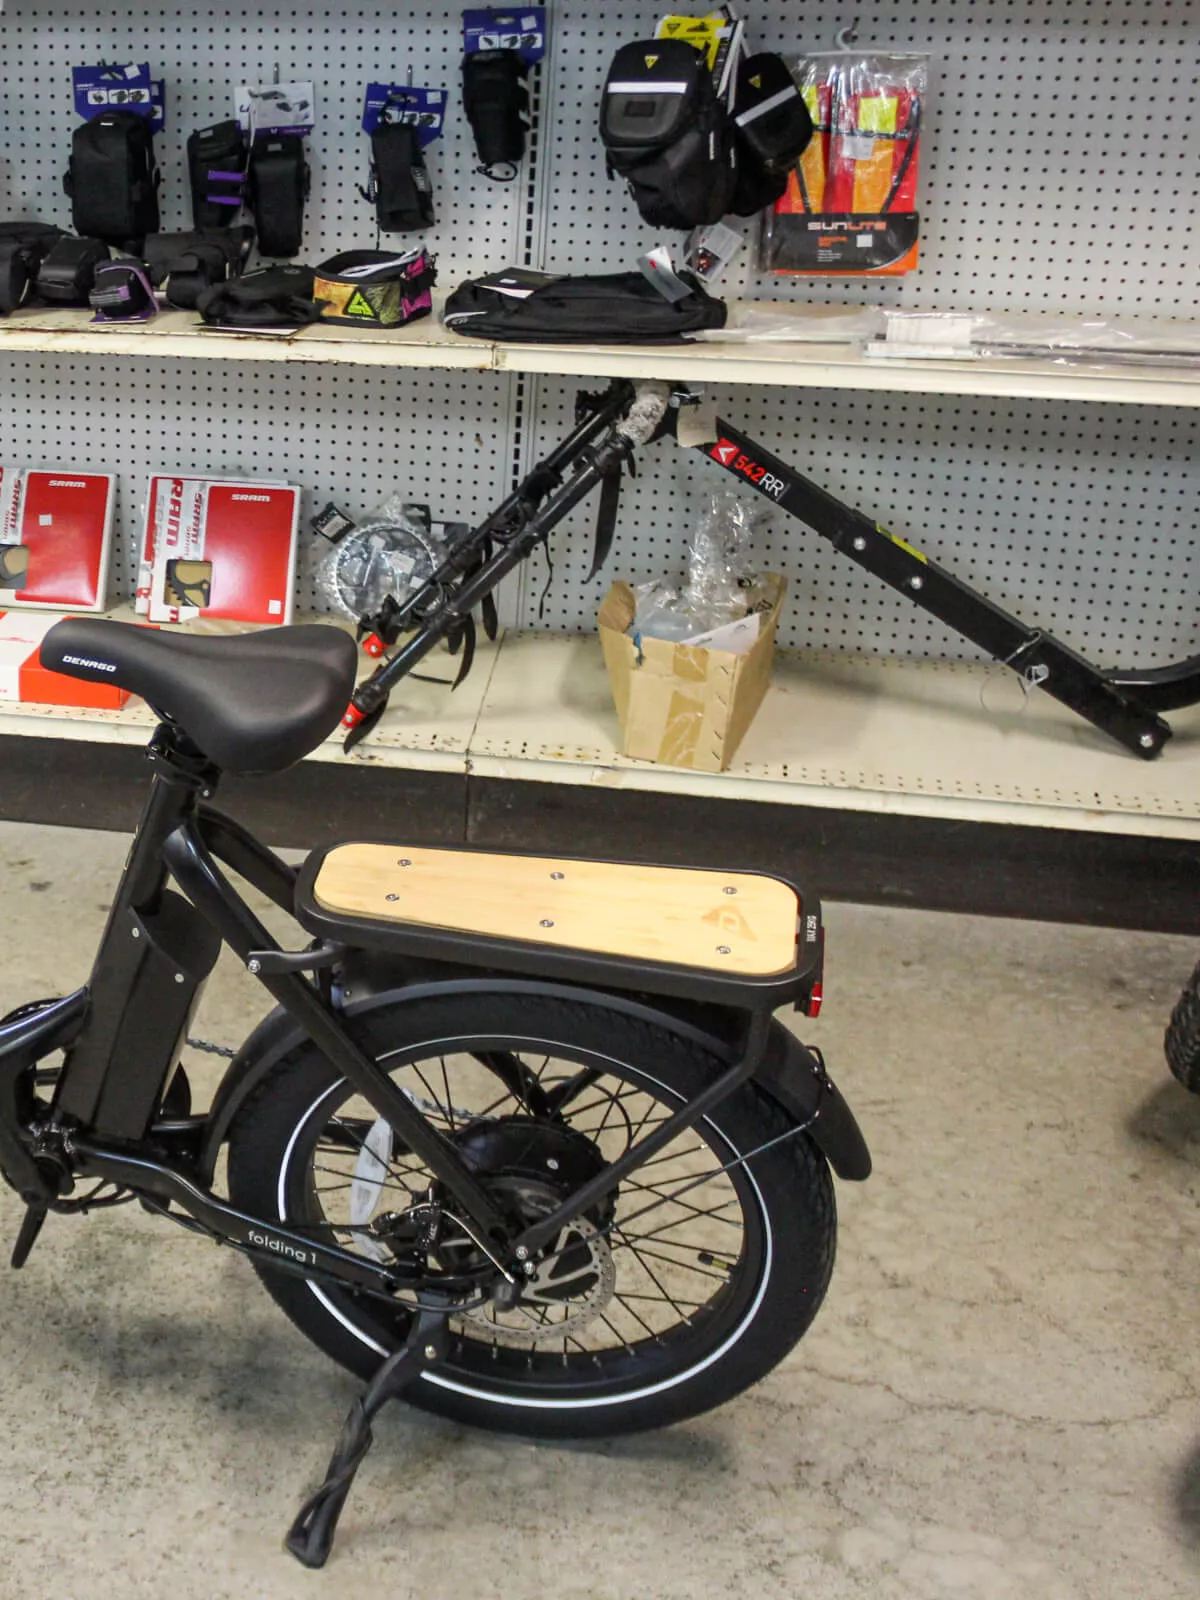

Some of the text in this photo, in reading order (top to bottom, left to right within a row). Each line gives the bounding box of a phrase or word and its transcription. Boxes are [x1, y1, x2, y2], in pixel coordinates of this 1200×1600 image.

[48, 480, 87, 488] SRAM
[231, 493, 271, 502] SRAM
[62, 654, 118, 673] DENAGO
[248, 1230, 317, 1265] folding 1
